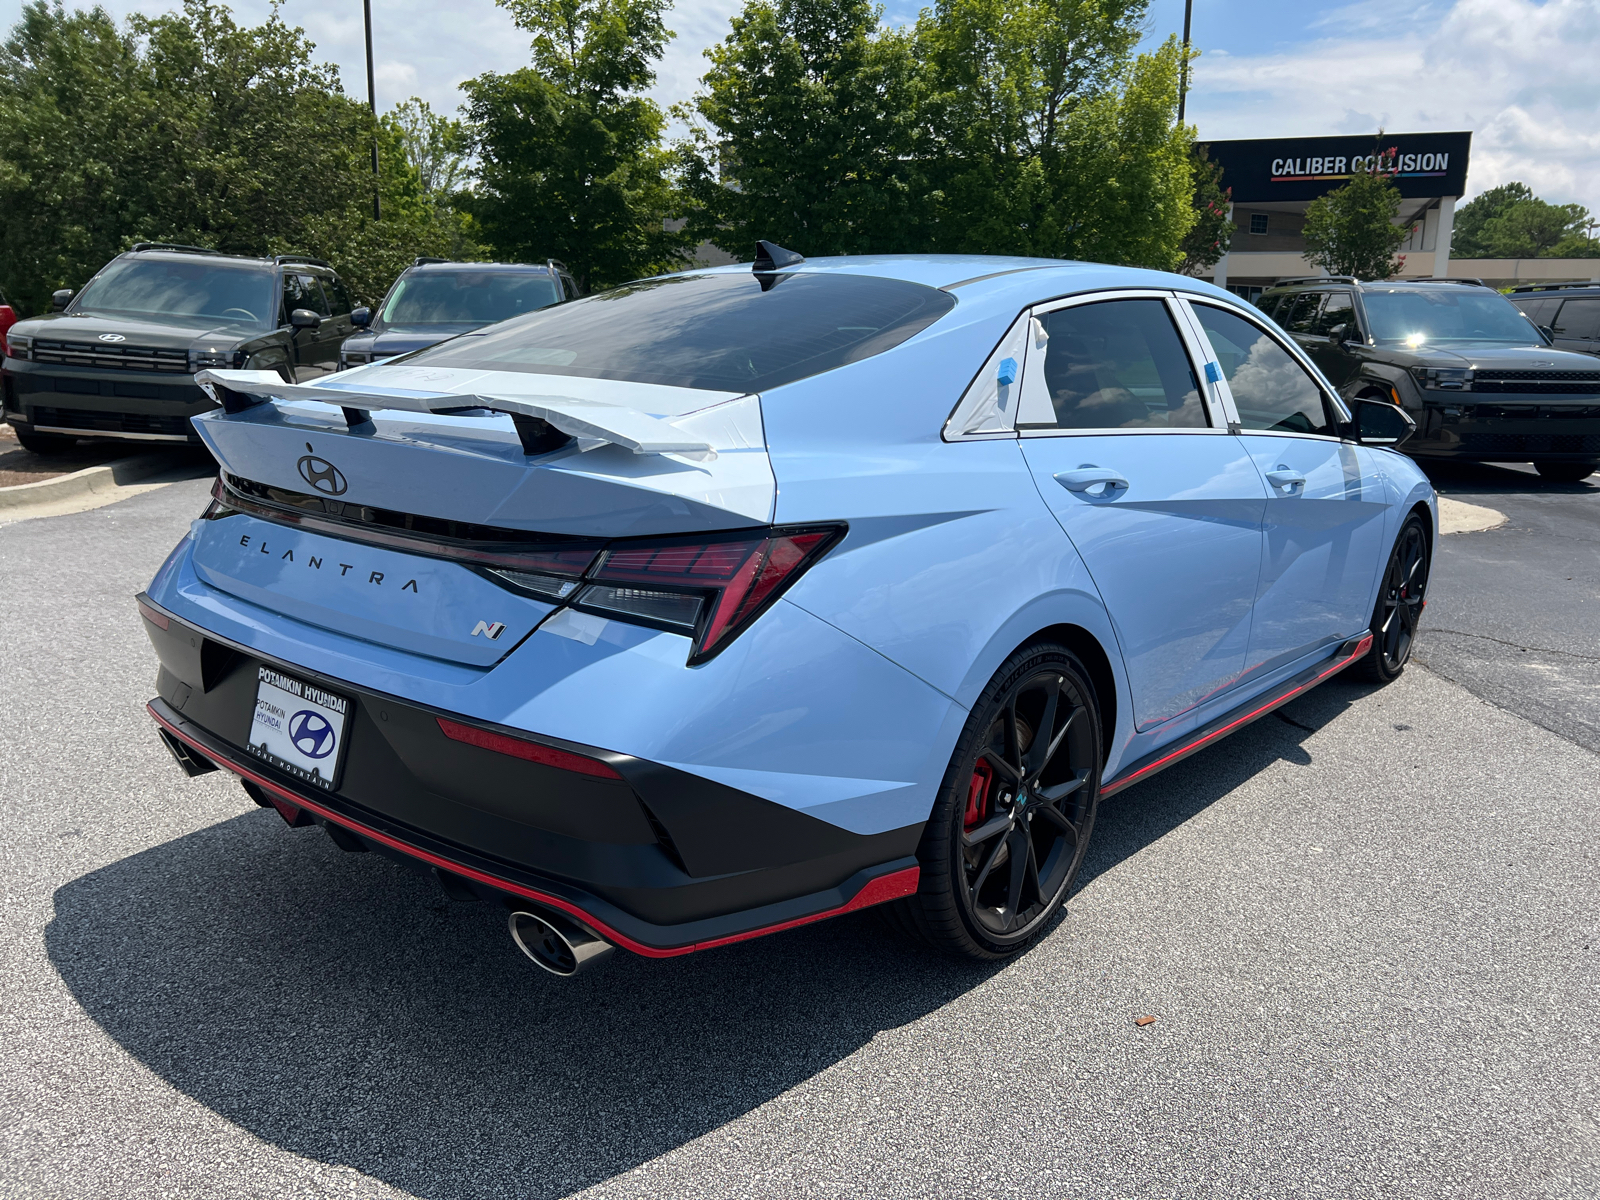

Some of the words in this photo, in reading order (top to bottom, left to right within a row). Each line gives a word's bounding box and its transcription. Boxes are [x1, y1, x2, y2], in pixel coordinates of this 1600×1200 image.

[1271, 156, 1347, 176] CALIBER
[239, 534, 418, 594] ELANTRA
[1004, 655, 1043, 690] MICHELIN
[259, 668, 301, 695] POTAMKIN
[305, 686, 346, 713] HYUNDAI
[256, 698, 286, 720] POTAMKIN
[256, 710, 282, 729] HYUNDAI
[247, 745, 273, 762] STONE
[280, 762, 329, 789] MOUNTAIN
